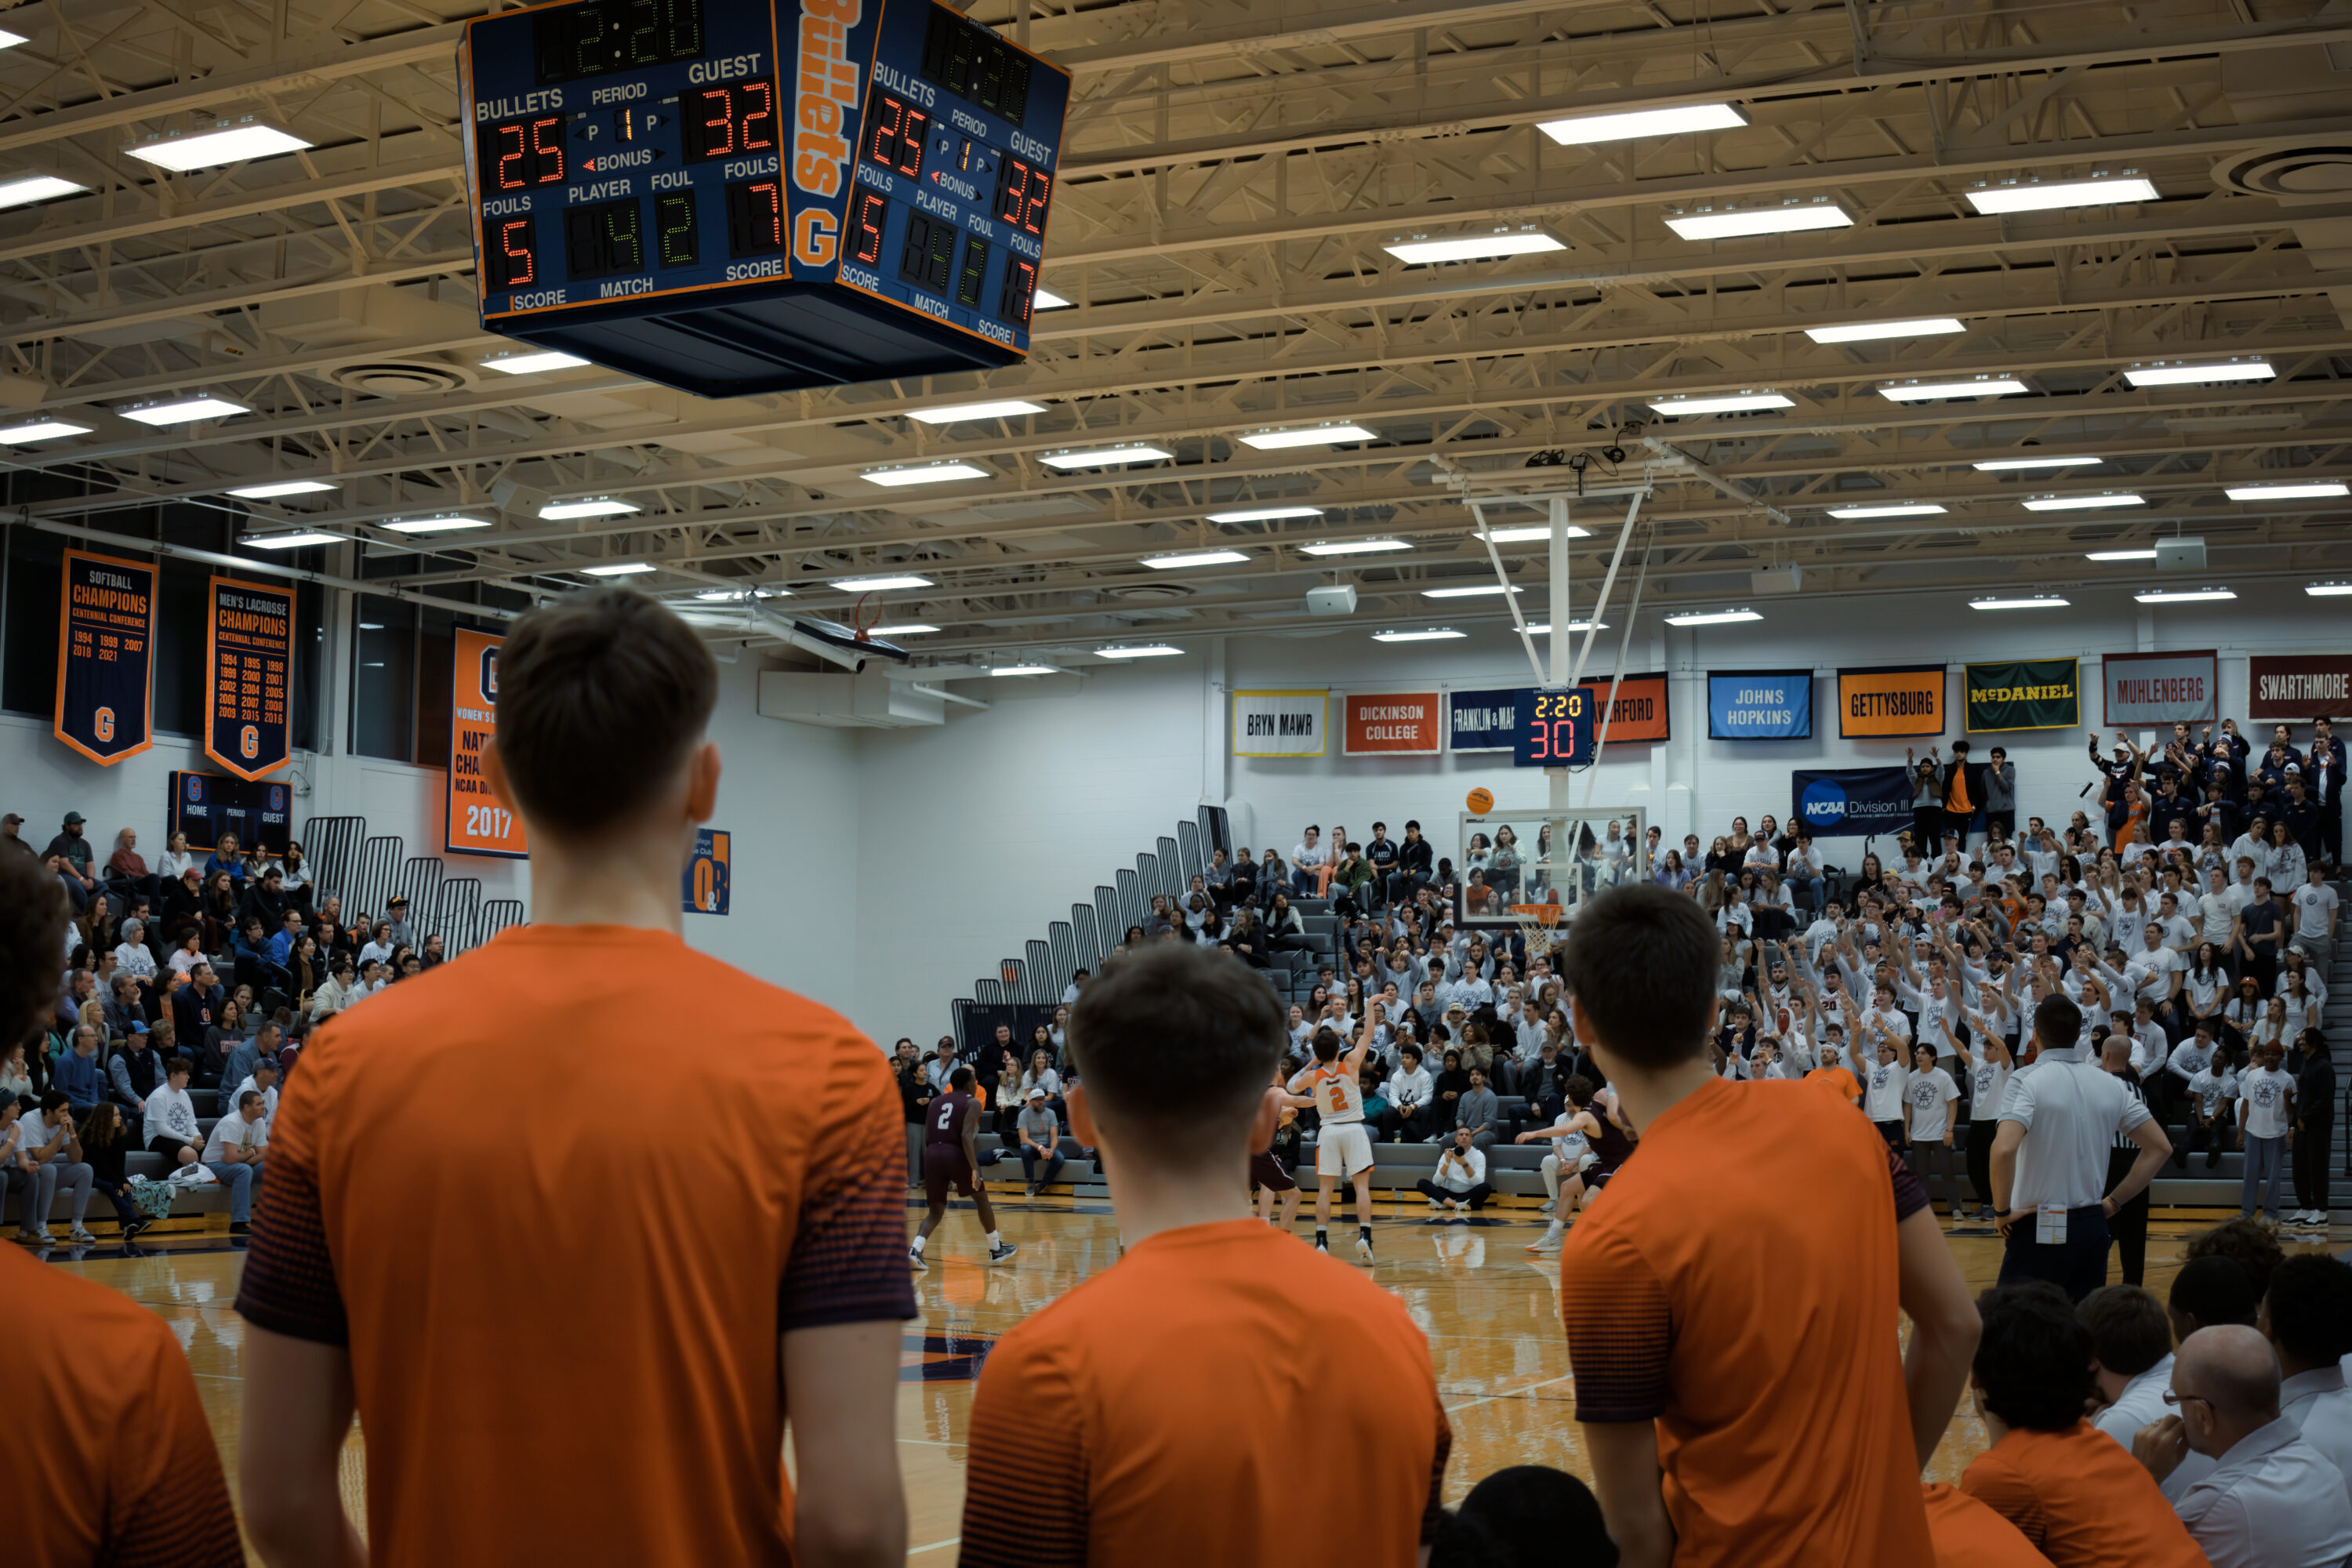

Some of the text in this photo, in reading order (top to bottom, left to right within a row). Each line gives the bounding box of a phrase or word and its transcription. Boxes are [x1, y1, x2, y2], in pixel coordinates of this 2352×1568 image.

[968, 17, 1002, 40] DAKTRONICS
[689, 53, 760, 84] GUEST
[592, 82, 647, 105] PERIOD
[874, 62, 935, 107] BULLETS
[477, 89, 563, 122] BULLETS
[588, 115, 658, 140] P P
[625, 109, 632, 141] 1
[702, 82, 771, 156] 32
[952, 110, 986, 137] PERIOD
[873, 98, 926, 176] 25
[1011, 132, 1051, 166] GUEST
[499, 118, 564, 189] 25
[597, 149, 652, 172] BONUS
[941, 140, 985, 173] P P
[963, 142, 971, 171] 1
[651, 171, 693, 191] FOUL
[724, 158, 778, 179] FOULS
[857, 164, 892, 192] FOULS
[568, 180, 631, 204] PLAYER
[940, 172, 975, 201] BONUS
[1004, 161, 1049, 234] 32
[483, 196, 532, 217] FOULS
[749, 183, 780, 245] 7
[916, 190, 957, 221] PLAYER
[608, 209, 639, 264] 4
[663, 198, 692, 263] 2
[793, 207, 838, 268] G
[858, 195, 884, 263] 5
[968, 214, 993, 238] FOUL
[503, 221, 533, 285] 5
[1011, 234, 1042, 259] FOULS
[726, 260, 782, 281] SCORE
[933, 230, 953, 289] 4
[960, 240, 985, 304] 2
[601, 278, 653, 299] MATCH
[841, 265, 879, 292] SCORE
[514, 290, 566, 311] SCORE
[1018, 263, 1035, 321] 7
[915, 292, 949, 320] MATCH
[978, 319, 1011, 344] SCORE
[89, 570, 132, 590] SOFTBALL
[73, 584, 147, 615] CHAMPIONS
[220, 593, 287, 616] MEN'S LACROSSE
[72, 608, 145, 628] CENTENNIAL CONFERENCE
[219, 609, 286, 637] CHAMPIONS
[74, 630, 143, 652] 1994 1999 2007
[74, 644, 117, 662] 2018 2021
[218, 631, 287, 650] CENTENNIAL CONFERENCE
[220, 653, 284, 673] 1994 1995 1998
[220, 666, 283, 686] 1999 2000 2001
[2259, 673, 2349, 700] SWARTHMORE
[219, 680, 284, 699] 2002 2004 2005
[1735, 689, 1784, 705] JOHNS
[1971, 684, 2074, 703] McDANIEL
[2118, 677, 2203, 704] MUHLENBERG
[219, 706, 283, 724] 2009 2015 2016
[241, 696, 260, 709] 2007
[264, 699, 283, 713] 2008
[456, 706, 490, 723] WOMEN'S
[1360, 706, 1424, 720] DICKINSON
[1535, 695, 1581, 718] 2:20
[1593, 698, 1653, 724] VRFORD
[1851, 691, 1933, 717] GETTYSBURG
[95, 706, 114, 742] G
[1247, 713, 1312, 736] BRYN MAWR
[1454, 708, 1490, 732] FRANKLIN
[1492, 712, 1498, 726] &
[1727, 710, 1791, 725] HOPKINS
[241, 725, 259, 759] G
[1366, 725, 1418, 741] COLLEGE
[1530, 720, 1574, 758] 30
[187, 775, 201, 801] G
[270, 786, 283, 810] G
[456, 778, 477, 793] NCAA
[187, 804, 207, 816] HOME
[227, 808, 245, 818] PERIOD
[263, 812, 284, 824] GUEST
[1806, 801, 1846, 815] NCAA
[1850, 799, 1909, 813] Division III
[466, 805, 512, 838] 2017
[1330, 1086, 1348, 1112] 2
[938, 1102, 953, 1130] 2
